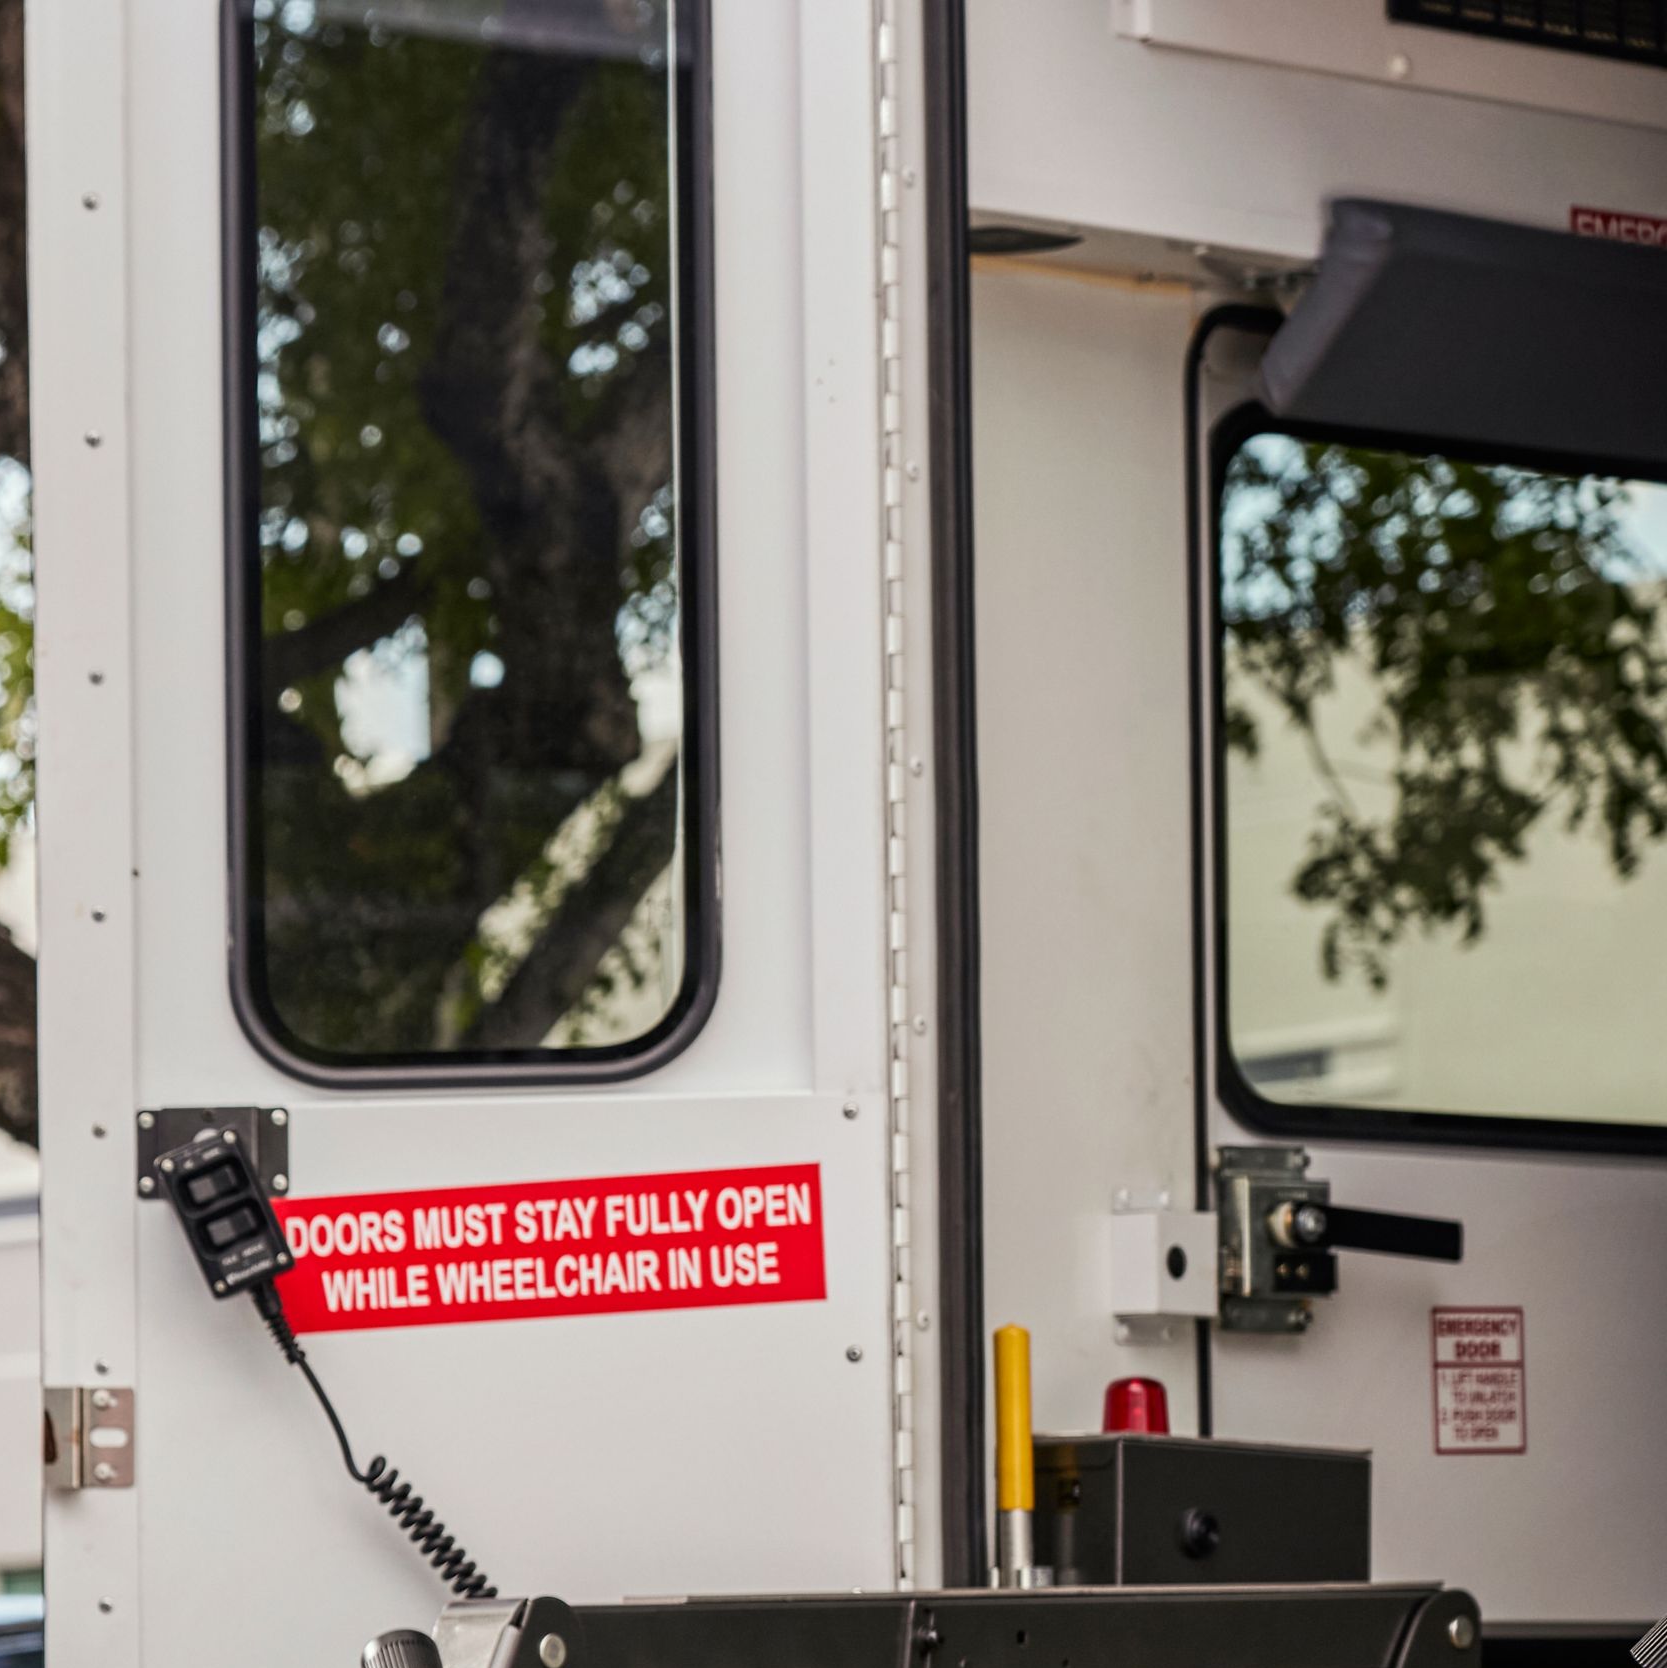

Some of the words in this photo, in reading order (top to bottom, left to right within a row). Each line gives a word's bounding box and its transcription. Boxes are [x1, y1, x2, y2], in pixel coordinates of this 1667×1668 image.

[285, 1210, 406, 1258] DOORS
[413, 1203, 507, 1250] MUST
[515, 1197, 598, 1243] STAY
[605, 1189, 709, 1237] FULLY
[717, 1183, 812, 1230] OPEN
[322, 1265, 430, 1312] WHILE
[436, 1250, 662, 1305] WHEELCHAIR
[668, 1246, 702, 1290] IN
[710, 1242, 780, 1287] USE
[1437, 1320, 1517, 1336] EMERGENCY
[1455, 1343, 1501, 1358] DOOR
[1486, 1409, 1516, 1421] DOOR
